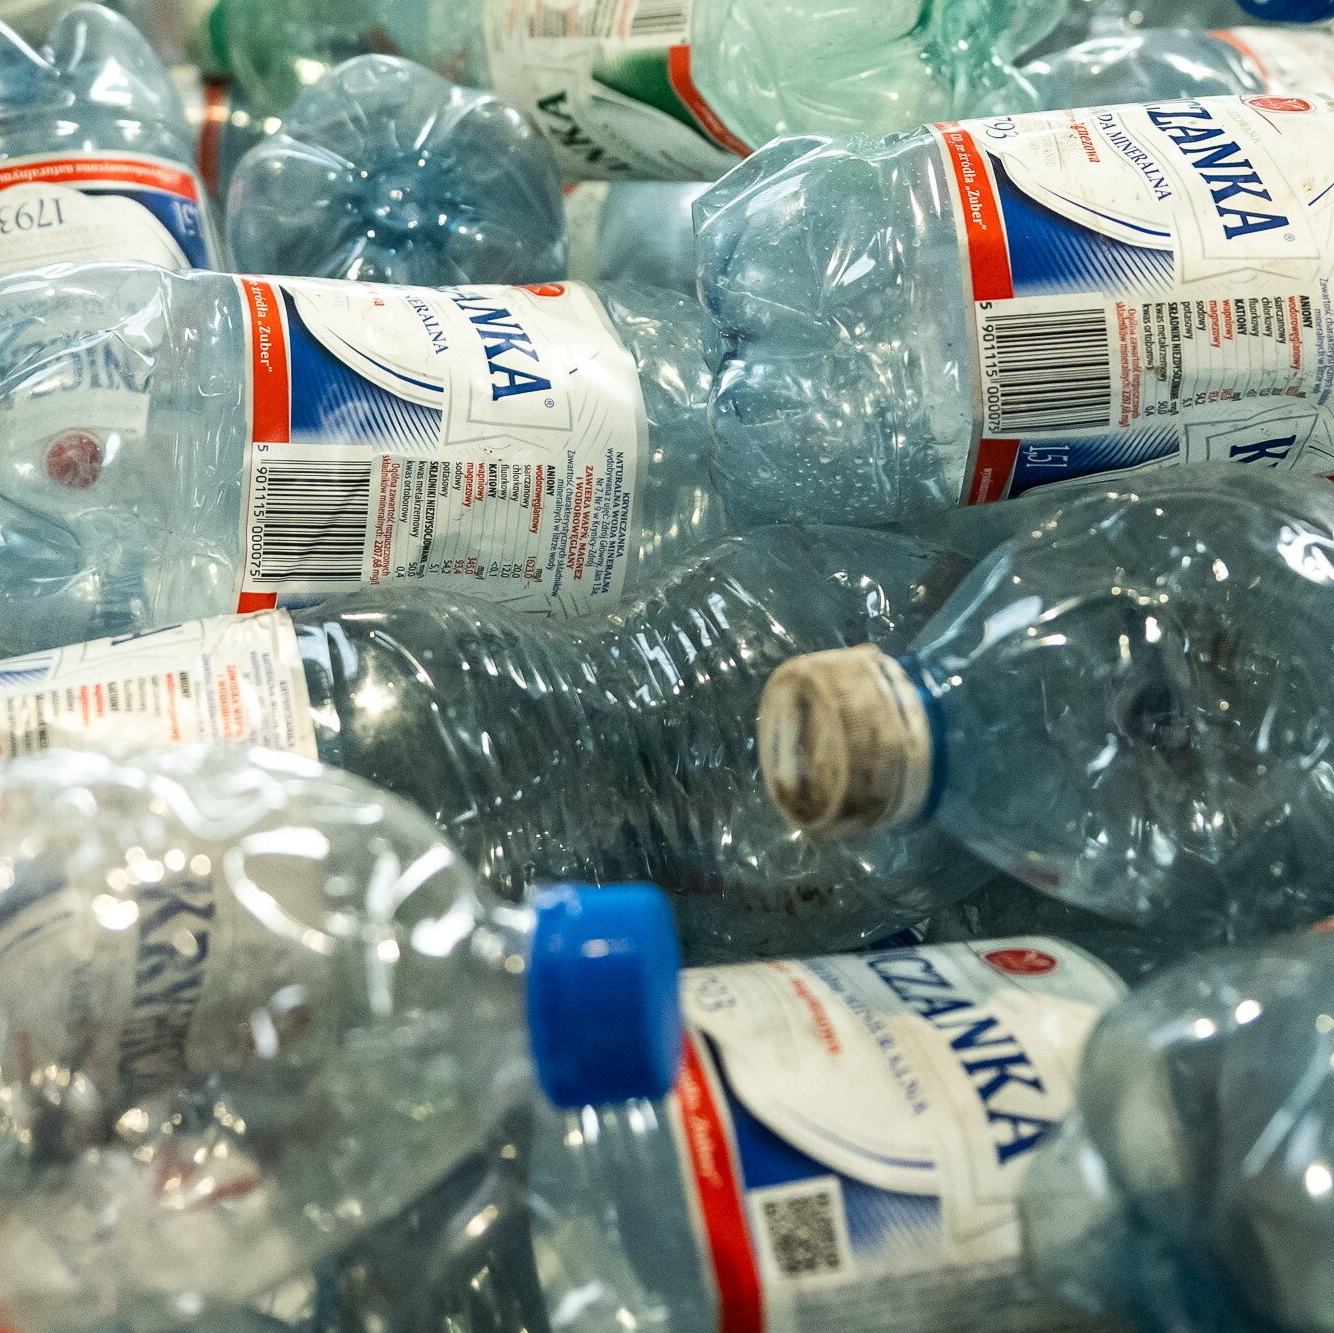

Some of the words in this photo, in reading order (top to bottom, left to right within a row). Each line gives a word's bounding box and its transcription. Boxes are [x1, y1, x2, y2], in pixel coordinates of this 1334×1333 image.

[955, 152, 977, 184] źródła
[1104, 128, 1175, 203] MINERALNA
[251, 286, 270, 317] źródła
[979, 302, 991, 310] 5
[1141, 303, 1153, 323] kwas
[1154, 302, 1165, 322] kwas
[1299, 294, 1312, 328] ANIONY
[1318, 277, 1330, 315] Zawartość
[1167, 302, 1180, 341] SKŁADNIKI
[1180, 301, 1193, 339] potasowy
[1195, 300, 1206, 331] sodowy
[1208, 300, 1221, 348] magnezowy
[1221, 299, 1234, 340] wapniowy
[1234, 298, 1247, 335] KATIONY
[1248, 297, 1260, 336] fluorkowy
[1261, 296, 1273, 337] chlorkowy
[1273, 296, 1287, 344] siarczanowy
[1286, 296, 1300, 370] wodorowęglanowy
[1313, 308, 1325, 357] mineralnych
[981, 324, 998, 378] 901115
[986, 386, 1002, 432] 000075
[256, 443, 269, 451] 5
[1228, 428, 1297, 469] K
[379, 454, 390, 493] składników
[388, 462, 400, 487] Ogólna
[404, 460, 414, 479] kwas
[416, 460, 426, 479] kwas
[426, 460, 438, 499] SKŁADNIKI
[439, 461, 450, 497] potasowy
[452, 461, 463, 490] sodowy
[462, 462, 473, 507] magnezowy
[474, 462, 485, 501] wapniowy
[487, 463, 497, 498] KATIONY
[497, 463, 509, 500] fluorkowy
[509, 464, 520, 501] chlorkowy
[521, 464, 531, 508] siarczanowy
[545, 464, 555, 496] ANIONY
[566, 449, 575, 486] Zawartość
[596, 477, 604, 486] Nr
[604, 447, 614, 495] wydobywana
[612, 451, 623, 507] NATURALNA
[252, 466, 269, 516] 901115
[399, 480, 412, 523] ortoborowy
[529, 464, 544, 533] wodorowęglanowy
[553, 478, 565, 522] mineralnych
[583, 465, 593, 509] ZAWIERA
[594, 495, 602, 505] Nr
[374, 494, 388, 539] mineralnych:
[386, 489, 398, 523] zawartość
[409, 480, 424, 537] metakrzemowy
[557, 487, 573, 559] charakterystycznych
[592, 511, 599, 519] w
[608, 509, 619, 538] WODA
[616, 492, 629, 557] KRYNICZANKA
[419, 499, 435, 564] NIEZDYSOCJOWANE
[550, 532, 559, 550] litrze
[565, 481, 583, 569] WODOROWĘGLANY
[578, 510, 591, 541] WAPŃ,
[585, 520, 600, 567] Krynicy-Zdrój
[598, 520, 610, 539] Zdrój
[249, 524, 264, 578] 000075
[371, 540, 383, 568] 2207,68
[380, 524, 393, 576] rozpuszczonych
[428, 563, 438, 573] 5,1
[440, 559, 450, 574] 54,2
[452, 559, 463, 575] 93,4
[464, 556, 476, 575] 345,0
[488, 560, 498, 577] <0,1
[523, 555, 535, 579] 1623,0
[545, 551, 556, 570] wody
[573, 542, 586, 580] MAGNEZ
[594, 539, 608, 568] Główny,
[601, 540, 615, 593] MINERALNA
[367, 568, 380, 585] mg/l
[394, 565, 404, 578] 0,4
[406, 561, 417, 577] 50,0
[474, 565, 485, 580] mg/l
[499, 563, 510, 578] 12,0
[511, 563, 522, 578] 20,0
[532, 568, 543, 583] mg/l
[551, 559, 564, 596] składników
[594, 568, 602, 581] Jan
